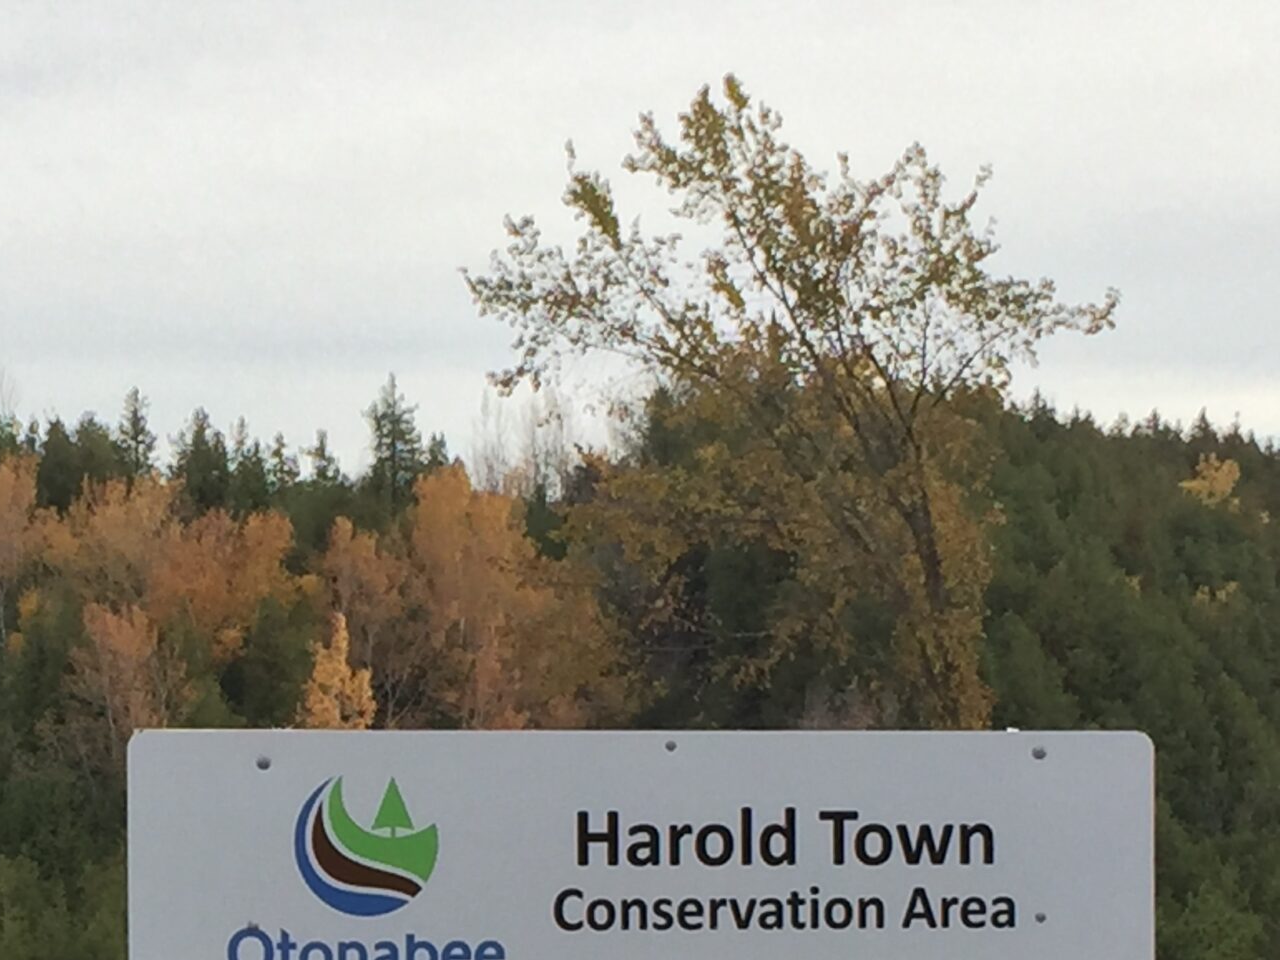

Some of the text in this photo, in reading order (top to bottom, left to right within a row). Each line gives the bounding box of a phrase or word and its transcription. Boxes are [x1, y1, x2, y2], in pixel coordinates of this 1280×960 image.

[576, 806, 995, 868] Harold Town
[553, 885, 1016, 932] Conservation Area
